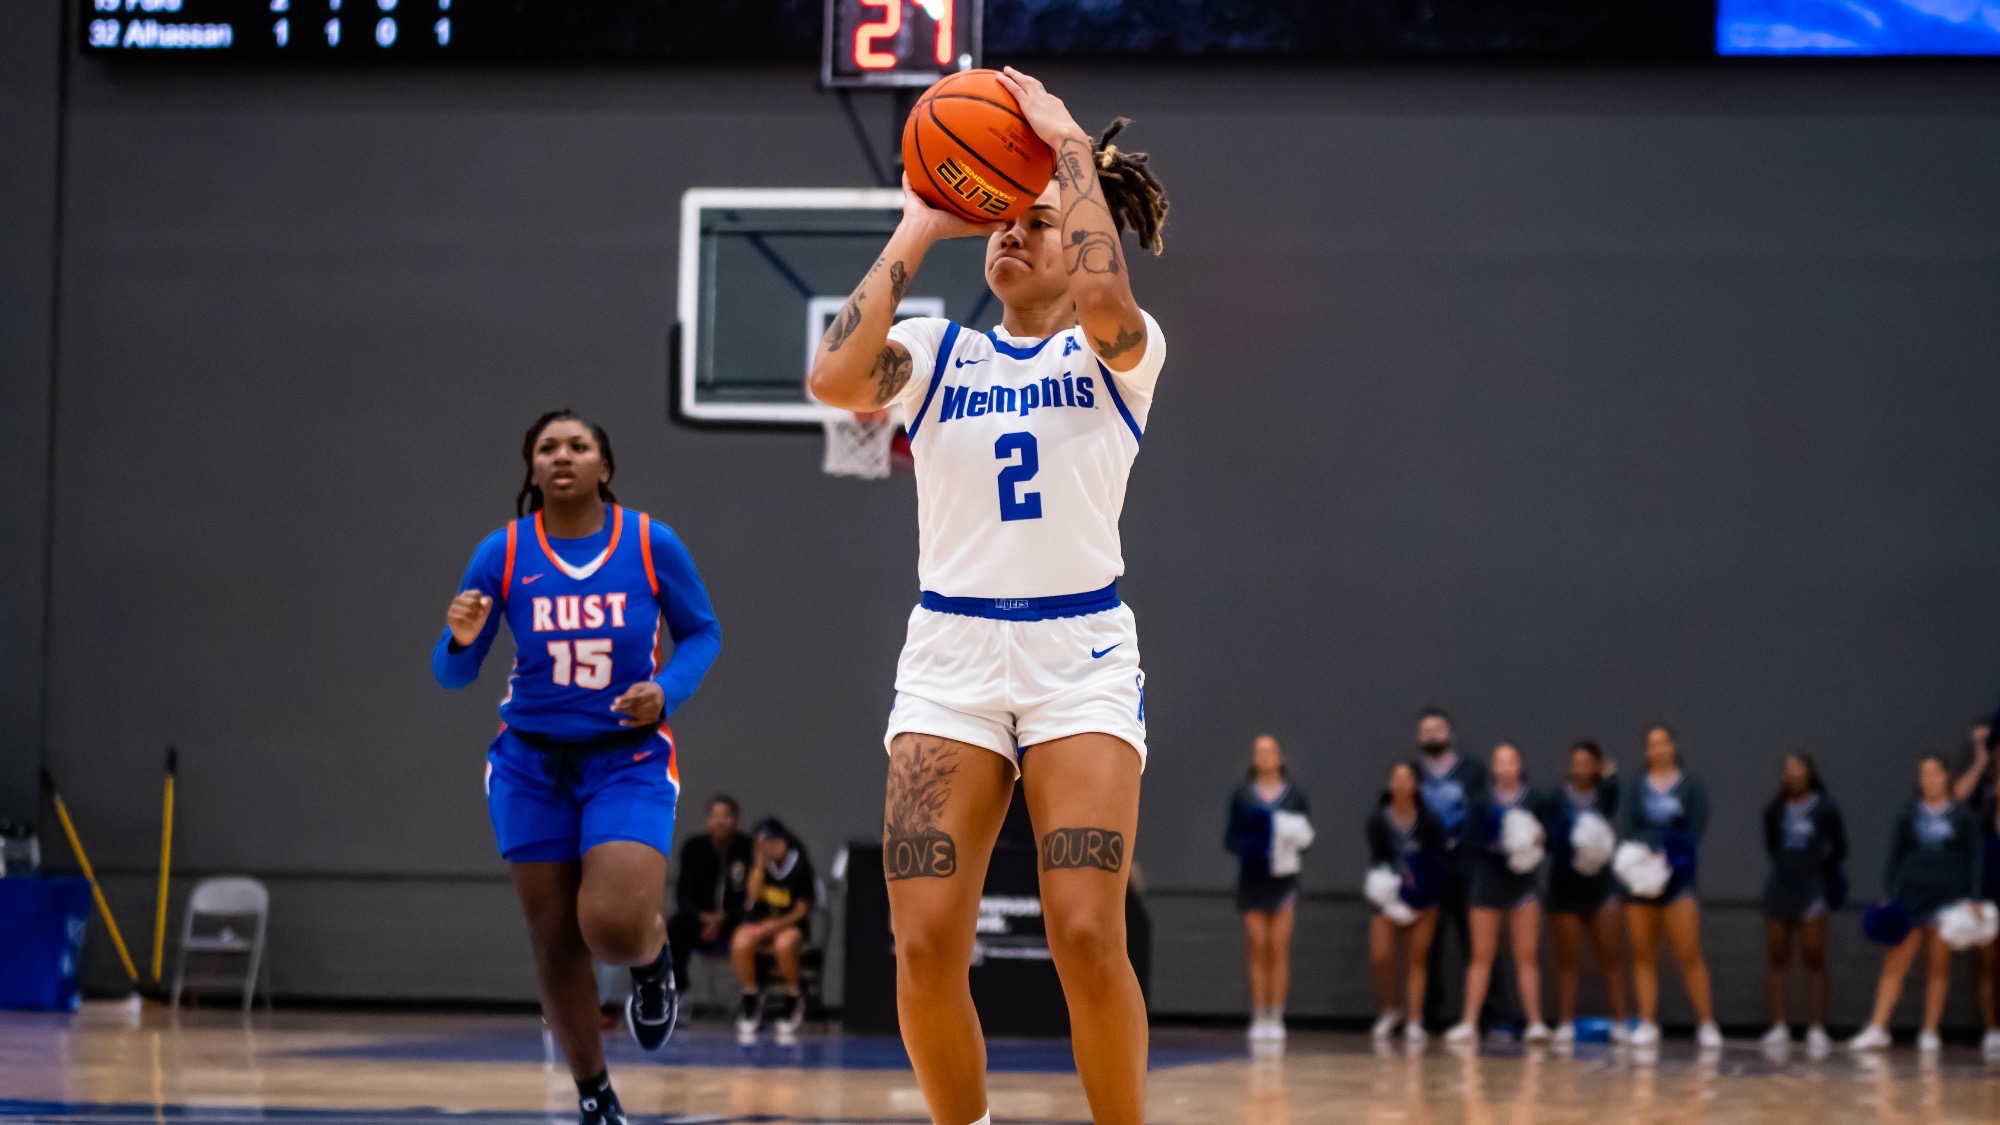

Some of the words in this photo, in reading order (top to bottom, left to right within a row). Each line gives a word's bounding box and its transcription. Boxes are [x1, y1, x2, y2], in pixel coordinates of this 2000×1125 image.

[89, 18, 120, 47] 32
[273, 18, 289, 47] 1
[324, 18, 340, 47] 1
[375, 17, 398, 47] 0
[434, 17, 451, 47] 1
[935, 157, 1012, 215] ELITE
[958, 159, 1017, 202] CHAMPIONSH
[938, 371, 1095, 423] Memphis
[994, 431, 1042, 521] 2
[532, 592, 627, 632] RUST
[547, 638, 614, 690] 15
[886, 840, 954, 878] LOVE
[1043, 831, 1123, 869] YOURS
